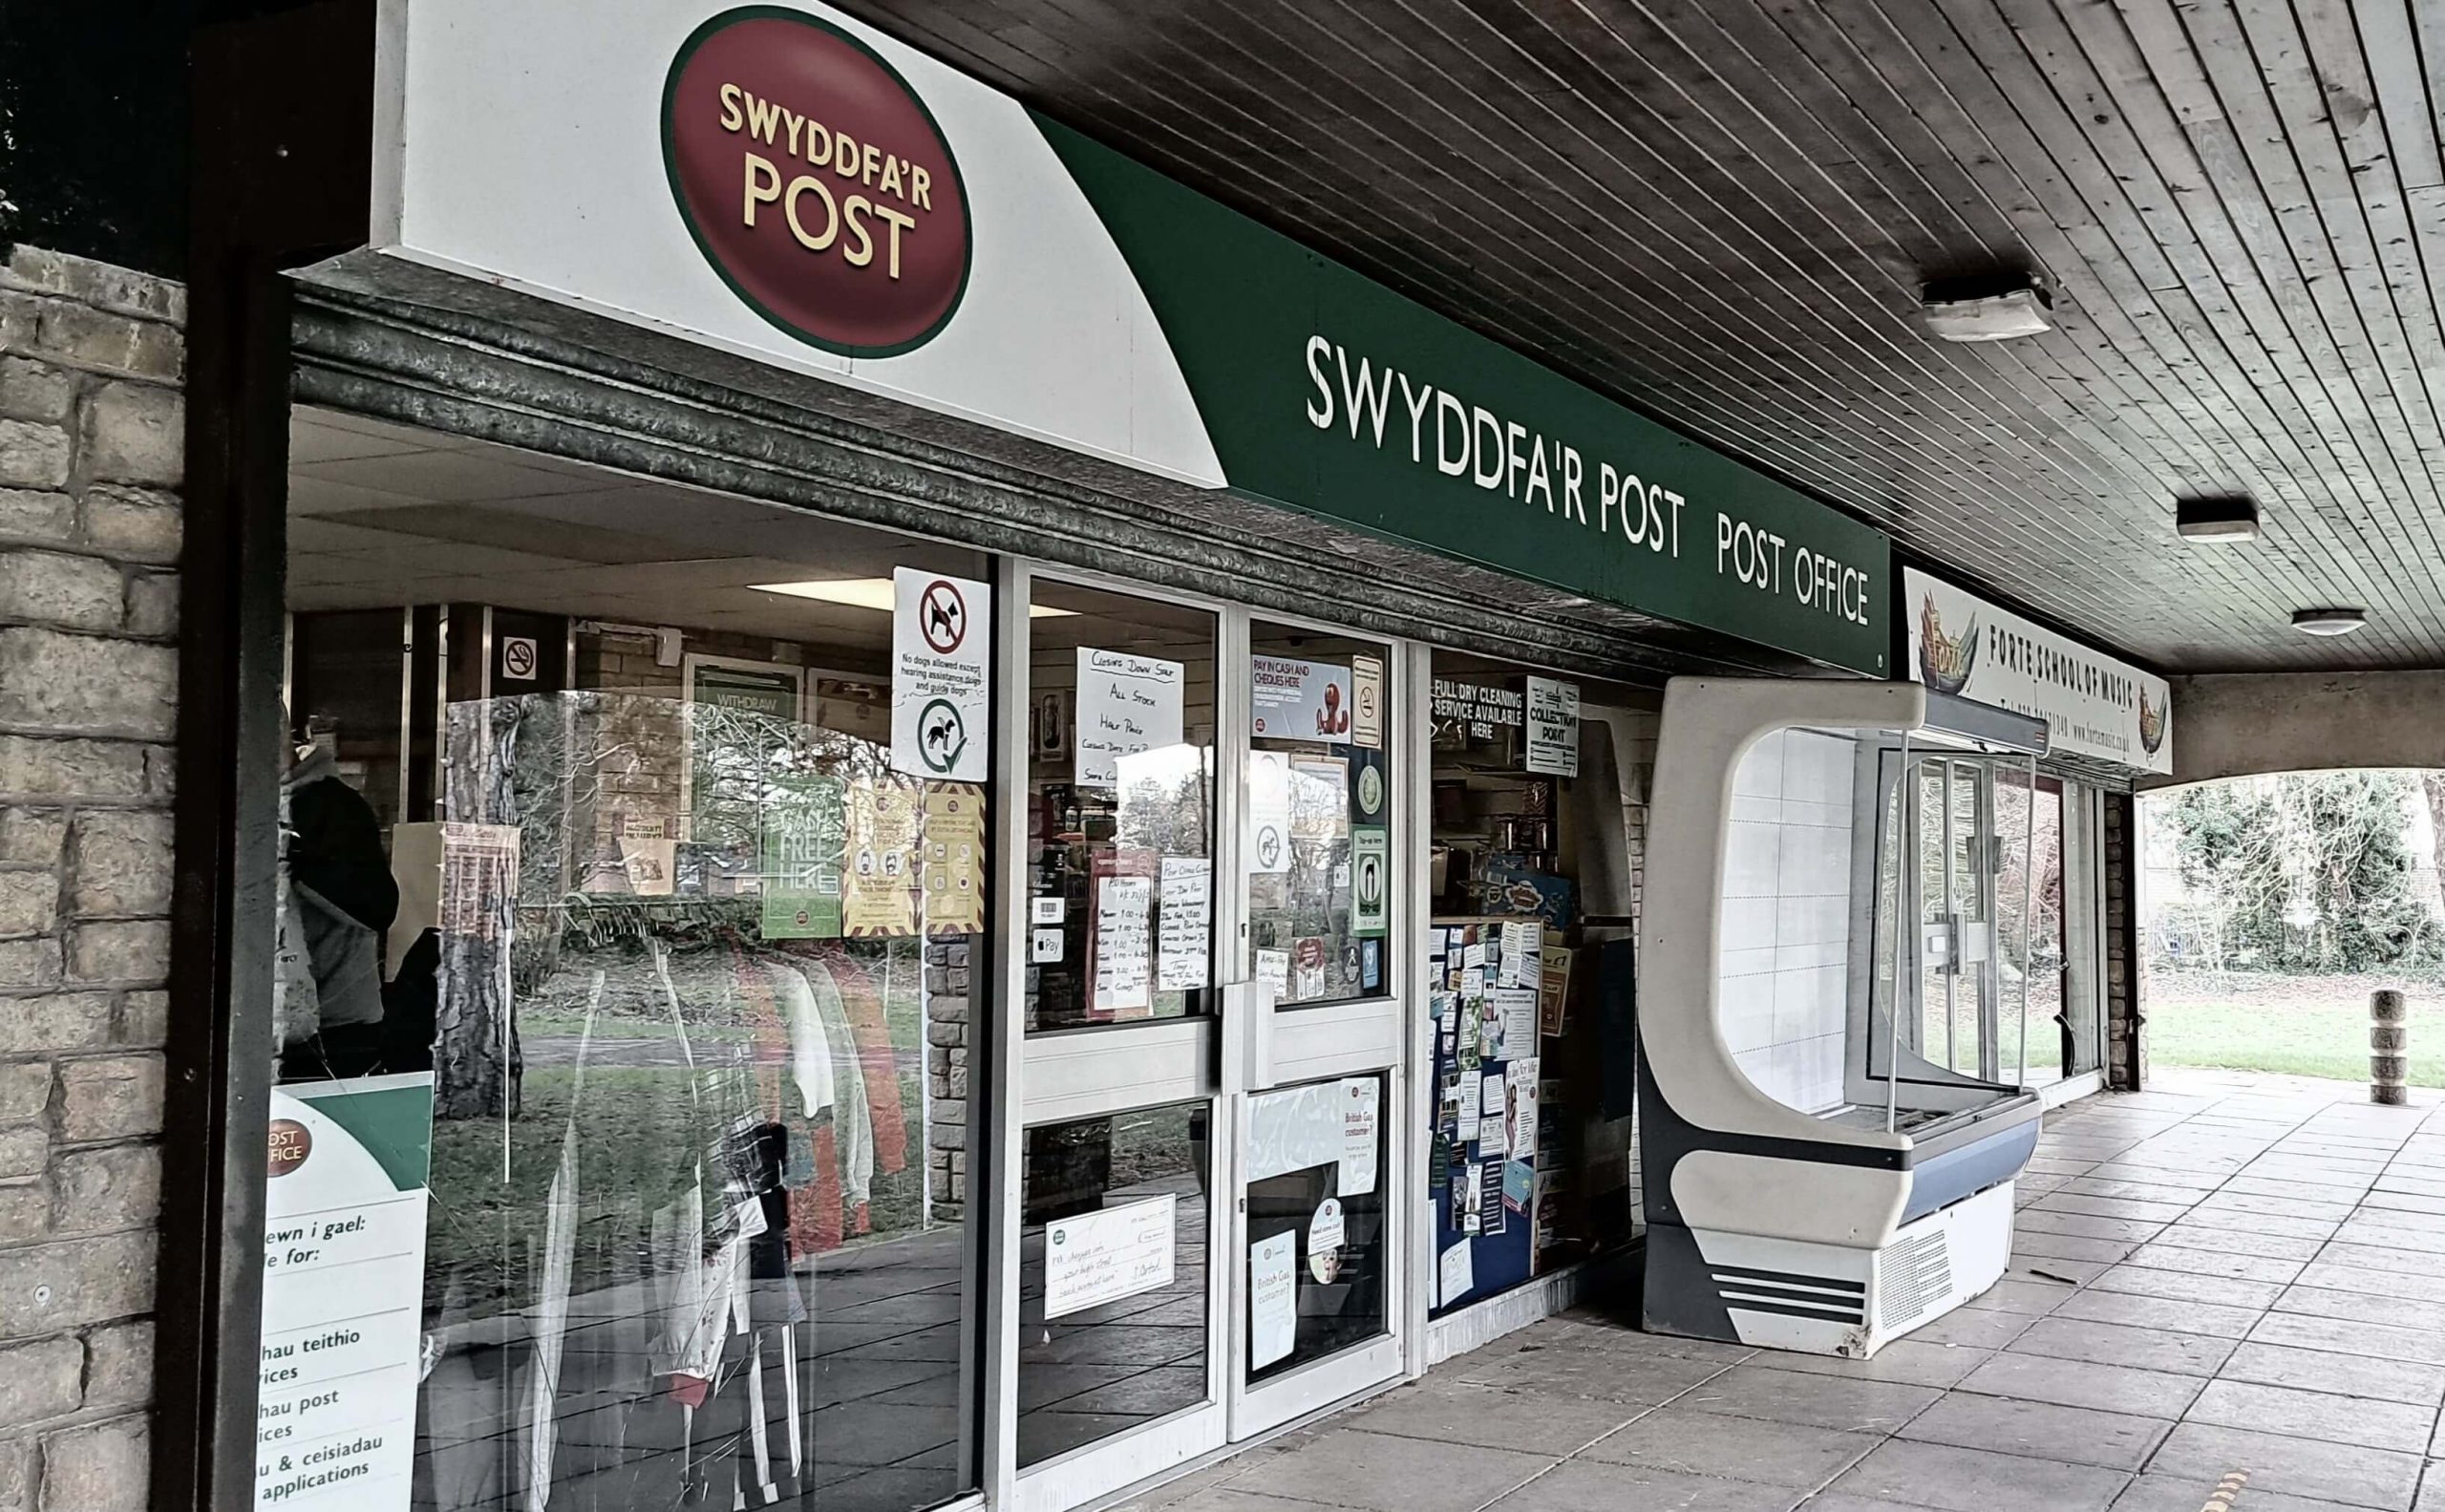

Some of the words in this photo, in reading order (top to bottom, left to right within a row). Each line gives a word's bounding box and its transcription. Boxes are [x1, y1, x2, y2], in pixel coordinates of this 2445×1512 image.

[720, 83, 931, 211] SWYDDFA'R
[744, 152, 915, 279] POST
[1307, 335, 1586, 525] SWYDDFA'R
[1601, 462, 1685, 558] POST
[1718, 512, 1786, 594] POST
[1795, 547, 1869, 626] OFFICE
[903, 654, 912, 663] No
[914, 656, 930, 667] dogs
[932, 659, 957, 670] allowed
[1254, 659, 1266, 671] PAY
[1268, 661, 1274, 672] IN
[1276, 663, 1293, 675] CASH
[1295, 666, 1309, 676] AND
[1990, 625, 2031, 675] FORTE
[2037, 645, 2081, 692] SCHOOL
[2085, 664, 2097, 697] OF
[2101, 670, 2132, 709] MUSIC
[902, 666, 926, 679] hearing
[929, 671, 963, 682] assistance
[1254, 673, 1285, 686] CHEQUES
[1286, 676, 1300, 688] HERE
[916, 682, 928, 691] and
[930, 685, 948, 694] guide
[950, 688, 967, 697] dogs
[1435, 679, 1456, 698] FULL
[1458, 684, 1477, 701] DRY
[1480, 687, 1521, 709] CLEANING
[717, 693, 777, 712] WITHDRAW
[1435, 699, 1473, 719] SERVICE
[1475, 705, 1521, 726] AVAILABLE
[1530, 707, 1576, 728] COLLECTION
[1471, 722, 1493, 739] HERE
[1542, 726, 1565, 743] POINT
[1045, 938, 1059, 954] Pay
[1346, 1111, 1362, 1123] British
[1364, 1111, 1373, 1121] Gas
[267, 1131, 298, 1146] OST
[1346, 1125, 1372, 1138] customer?
[268, 1146, 302, 1162] FICE
[266, 1228, 303, 1245] ewn
[311, 1222, 318, 1238] i
[323, 1215, 366, 1241] gael:
[287, 1248, 320, 1265] for:
[1258, 1272, 1277, 1289] British
[1259, 1283, 1289, 1305] customer?
[303, 1329, 360, 1352] teithio
[261, 1367, 298, 1384] ices
[299, 1390, 339, 1416] post
[258, 1425, 292, 1443] ices
[278, 1456, 292, 1472] &
[303, 1437, 383, 1466] ceisiadau
[263, 1462, 370, 1502] applications
